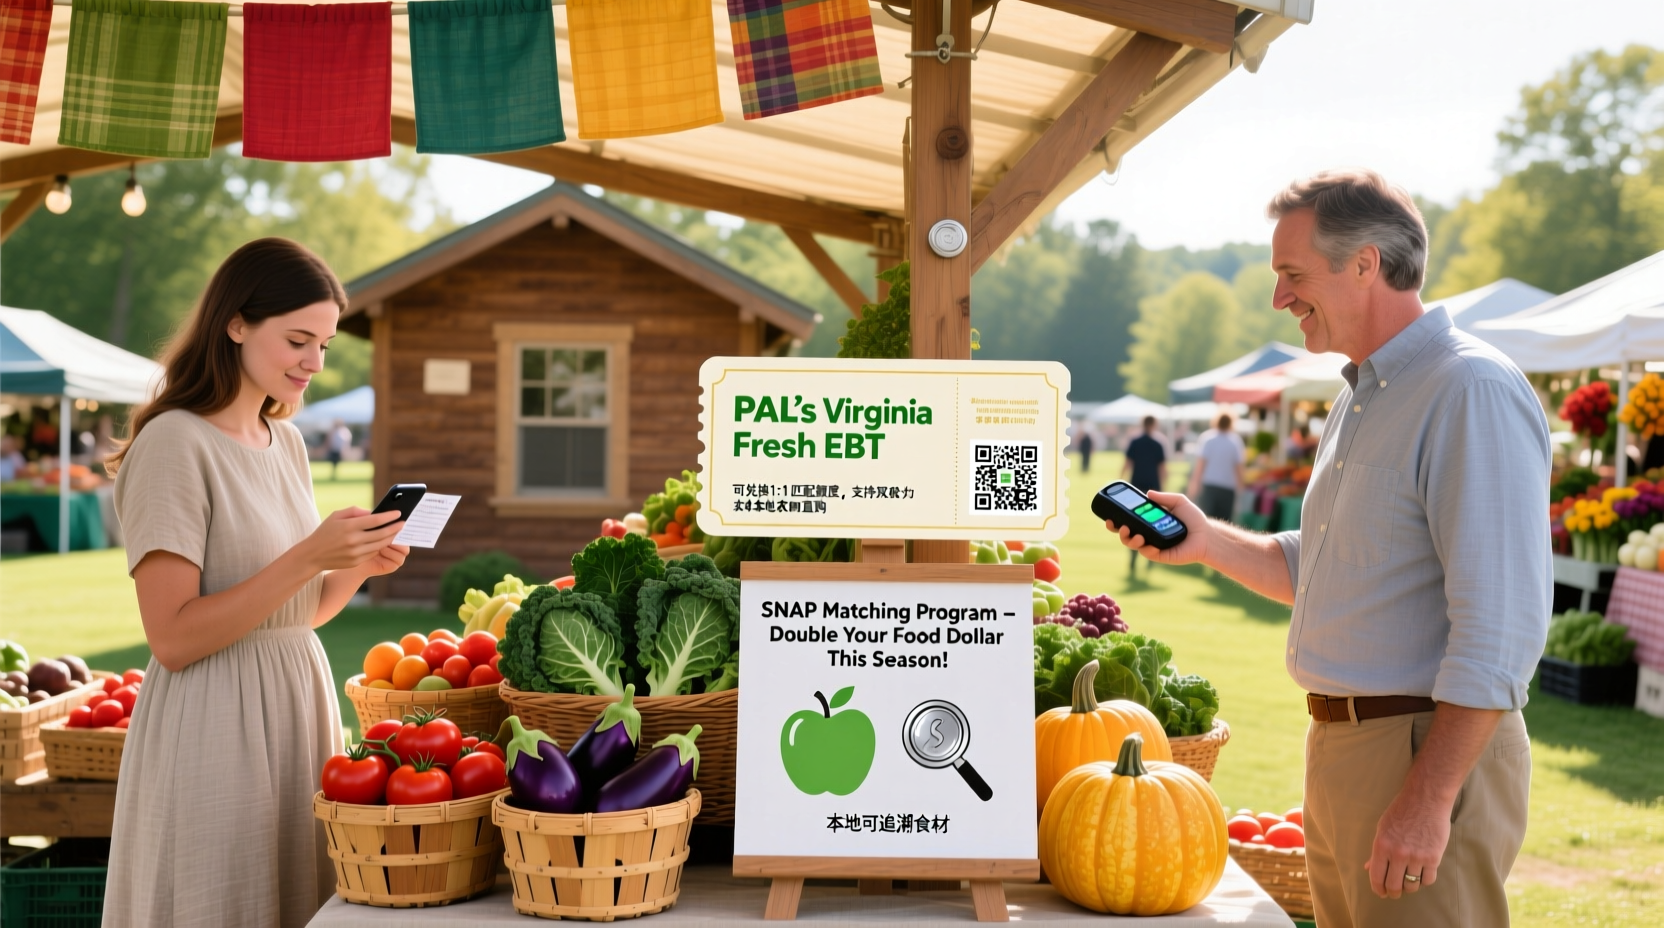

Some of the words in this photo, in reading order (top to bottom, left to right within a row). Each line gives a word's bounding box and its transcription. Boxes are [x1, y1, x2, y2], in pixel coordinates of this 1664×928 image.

[823, 397, 933, 431] Virginia
[733, 432, 816, 459] Fresh
[824, 433, 886, 460] EBT
[761, 601, 818, 619] SNAP
[823, 602, 911, 624] Matching
[916, 603, 998, 625] Program
[769, 626, 839, 643] Double
[843, 627, 889, 644] Your
[893, 627, 941, 645] Food
[946, 628, 1005, 645] Dollar
[827, 649, 867, 667] This
[872, 650, 949, 668] Season!
